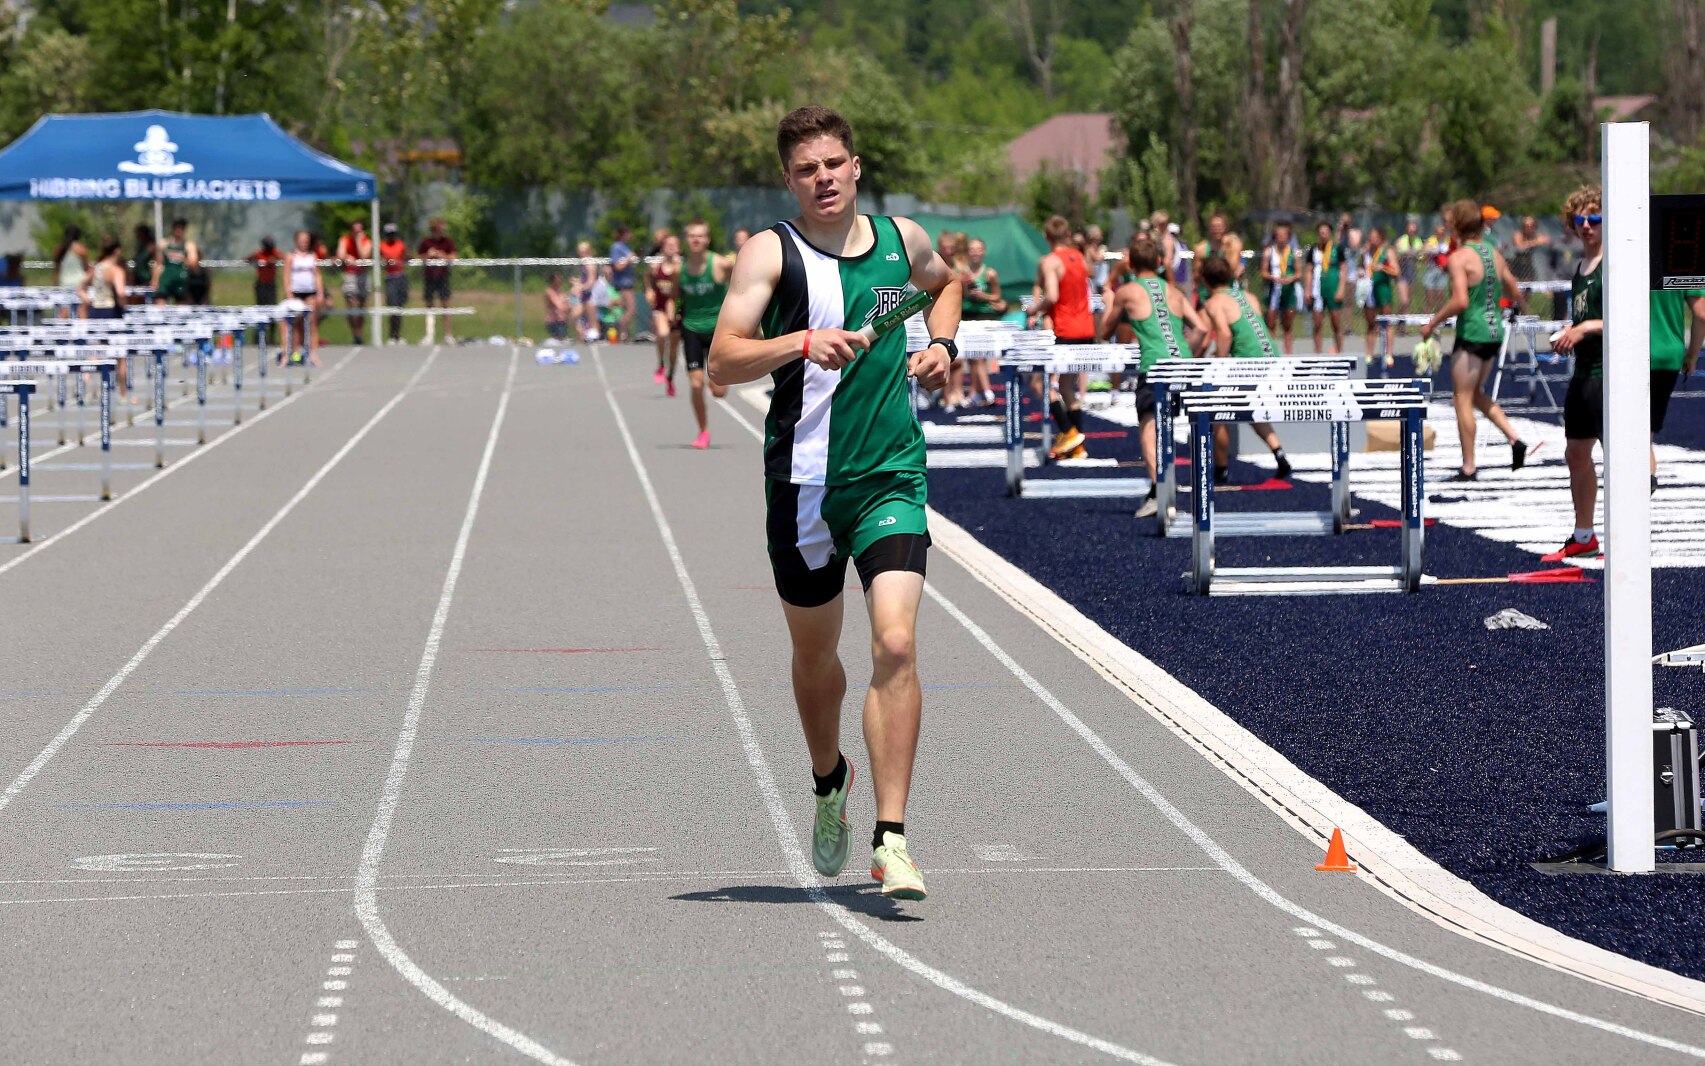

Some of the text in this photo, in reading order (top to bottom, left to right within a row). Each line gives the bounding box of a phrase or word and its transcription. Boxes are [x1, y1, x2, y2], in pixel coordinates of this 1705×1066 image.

[30, 177, 281, 200] HIBBING BLUEJACKETS
[1214, 409, 1401, 420] GILL HIBBING GILL
